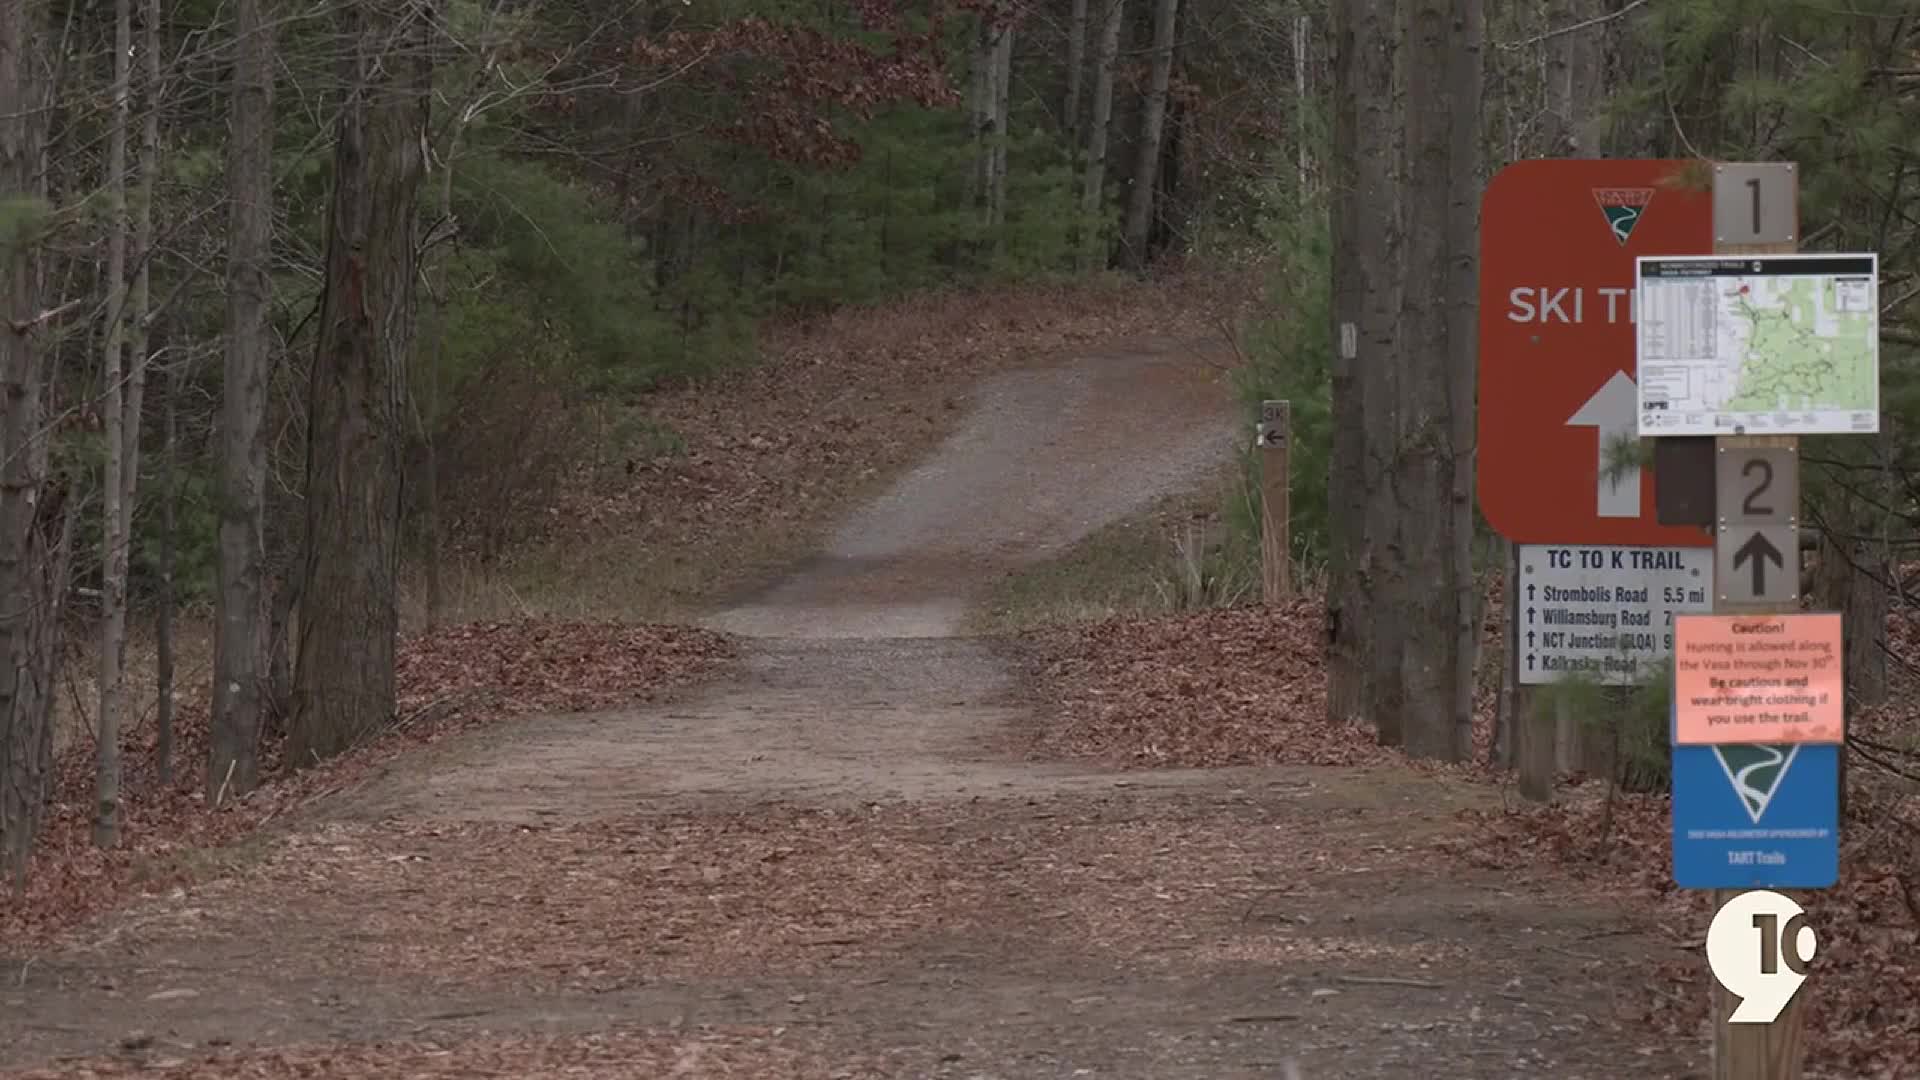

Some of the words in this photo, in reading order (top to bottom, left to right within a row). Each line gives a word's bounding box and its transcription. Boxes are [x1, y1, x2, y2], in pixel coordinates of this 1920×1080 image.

[1745, 178, 1761, 235] 1
[1507, 286, 1583, 323] SKI
[1743, 459, 1773, 515] 2
[1548, 550, 1571, 569] TC
[1579, 550, 1603, 569] TO
[1612, 551, 1624, 569] K
[1630, 551, 1685, 570] TRAIL
[1543, 586, 1611, 602] Strombolis
[1615, 587, 1648, 603] Road
[1664, 587, 1685, 603] 5.5
[1689, 587, 1704, 603] mi
[1543, 608, 1617, 628] Williamsburg
[1621, 610, 1651, 626] Road
[1731, 623, 1785, 634] Caution!
[1543, 632, 1565, 649] NCT
[1568, 632, 1616, 649] Junction
[1686, 641, 1733, 654] Hunting
[1735, 641, 1745, 652] is
[1749, 640, 1795, 652] allowed
[1799, 640, 1831, 654] along
[1604, 656, 1637, 672] Road
[1680, 660, 1698, 670] the
[1734, 659, 1781, 671] through
[1784, 658, 1808, 669] Nov
[1709, 677, 1726, 688] Be
[1729, 677, 1781, 688] cautious
[1784, 676, 1808, 687] and
[1691, 696, 1721, 706] wear
[1722, 695, 1763, 708] bright
[1766, 694, 1816, 708] clothing
[1819, 693, 1829, 704] if
[1707, 715, 1730, 726] you
[1734, 714, 1755, 724] use
[1759, 712, 1780, 723] the
